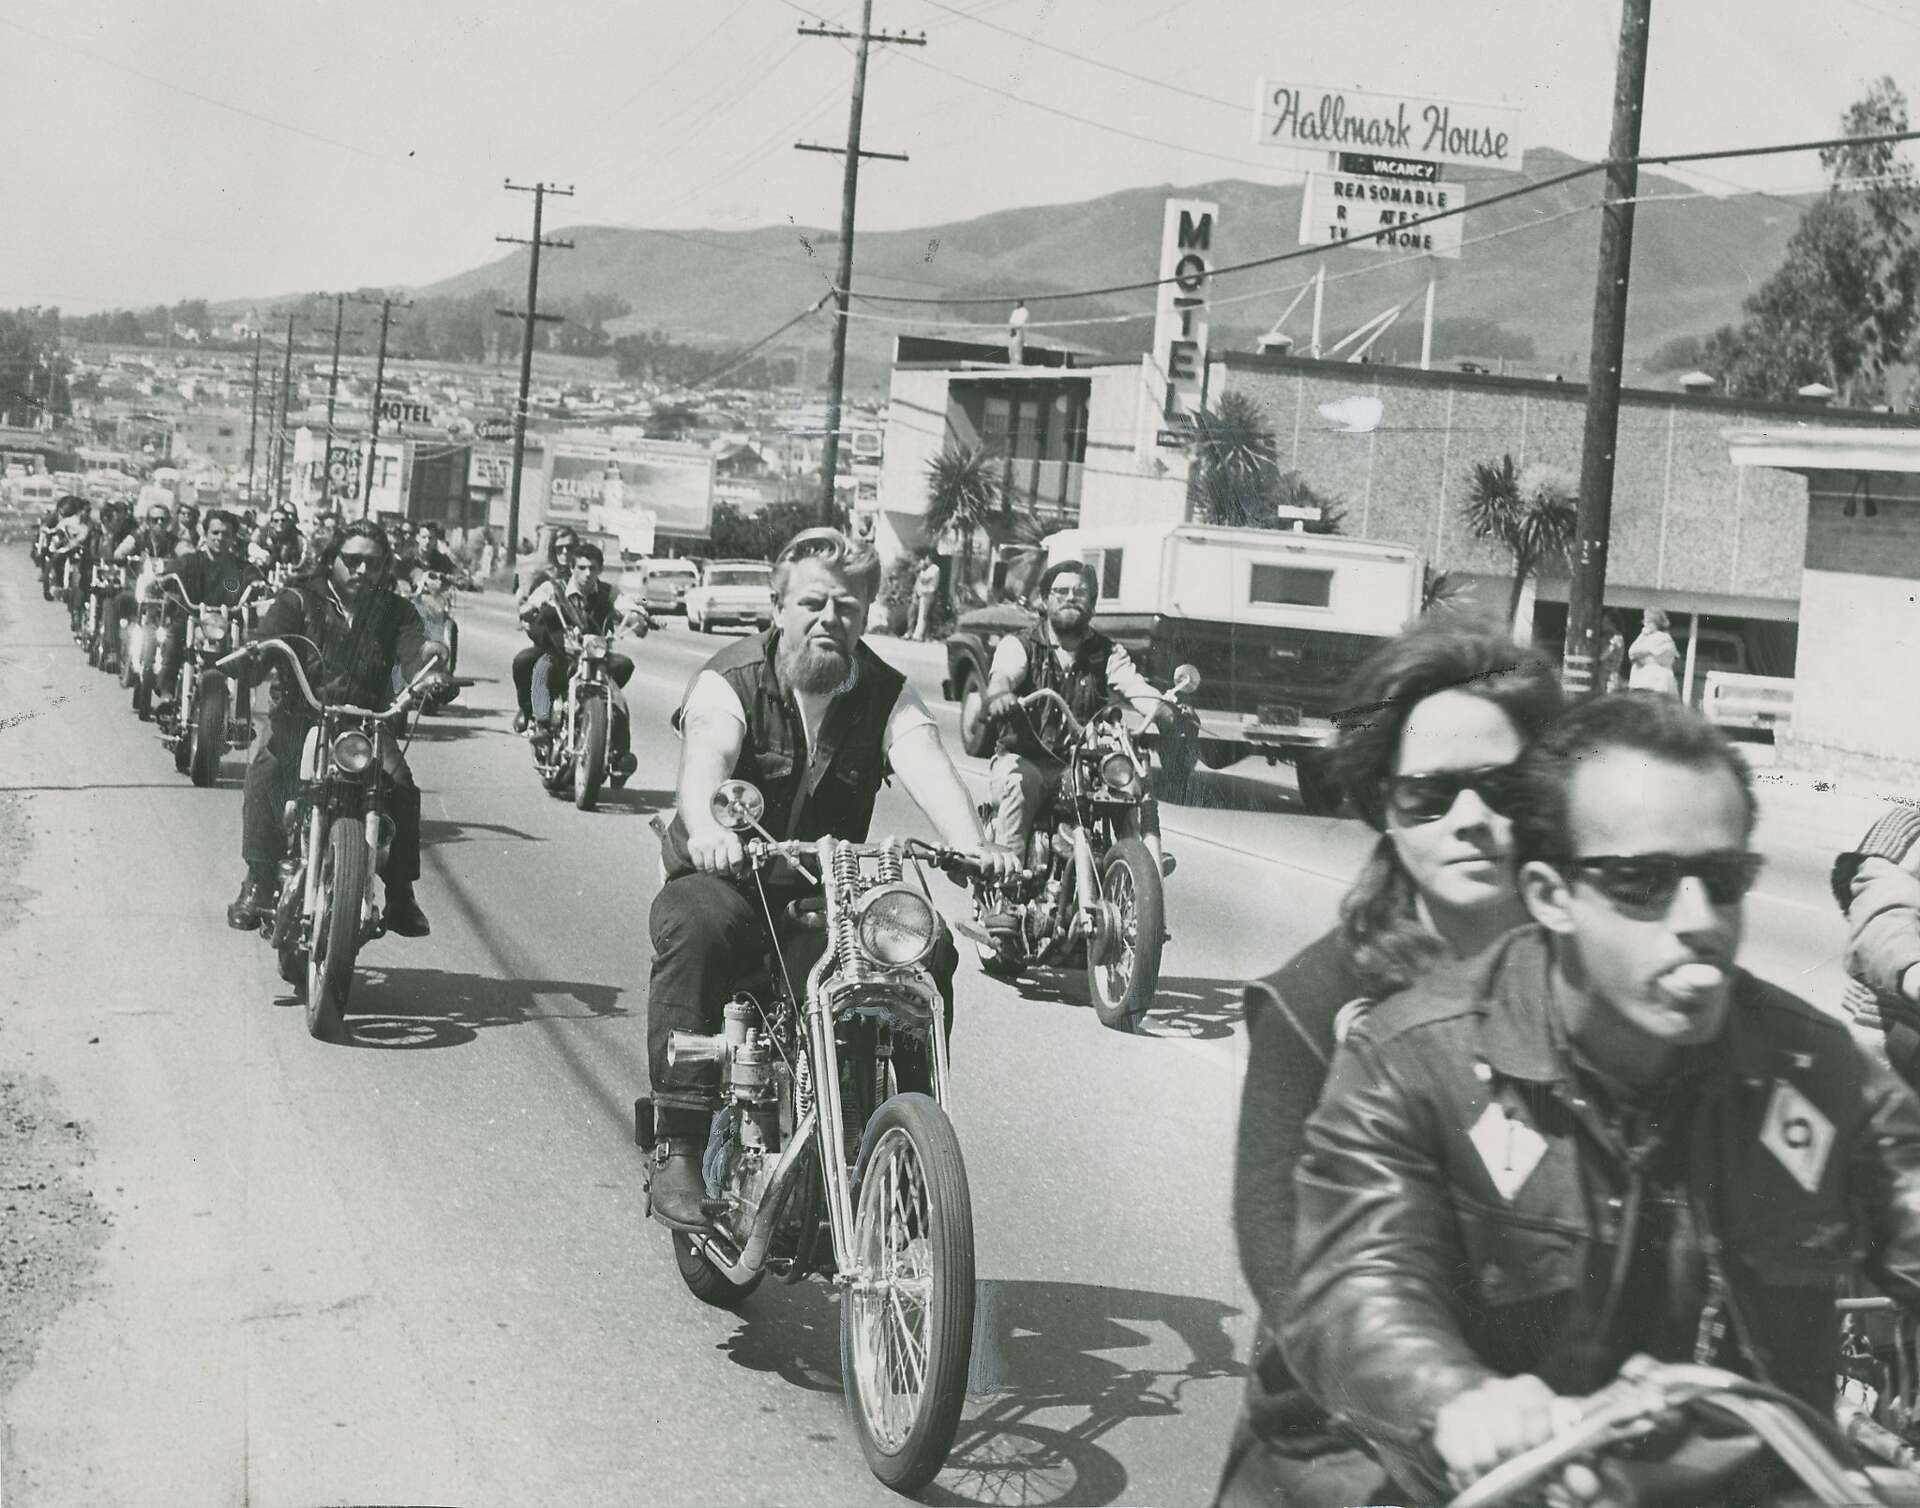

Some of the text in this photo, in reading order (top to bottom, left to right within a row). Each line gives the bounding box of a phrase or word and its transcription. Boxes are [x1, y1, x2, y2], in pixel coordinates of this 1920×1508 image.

[1272, 88, 1509, 160] Hallmark House
[1372, 159, 1434, 178] VACANCY
[1334, 181, 1447, 207] REASONABLE
[1376, 229, 1432, 249] PHONE
[1163, 210, 1212, 424] MOTEL
